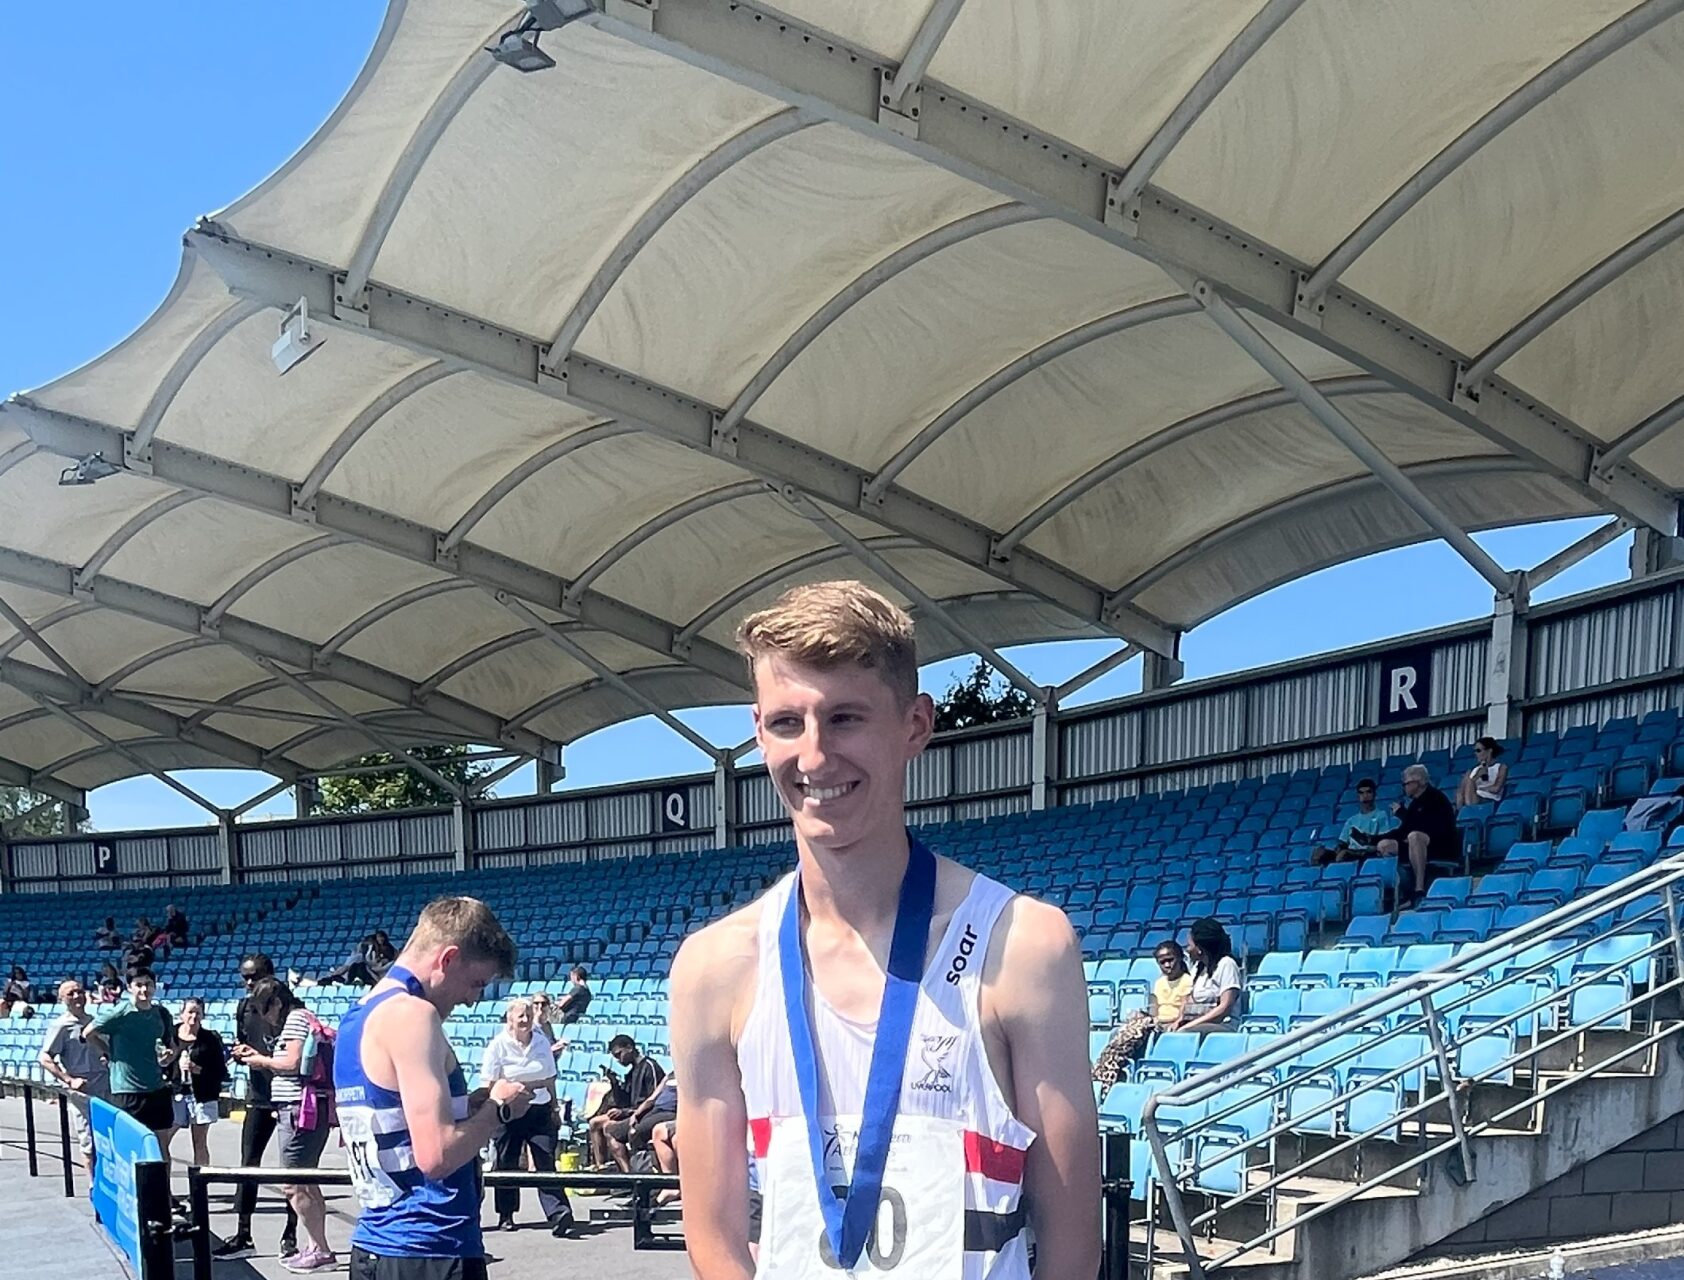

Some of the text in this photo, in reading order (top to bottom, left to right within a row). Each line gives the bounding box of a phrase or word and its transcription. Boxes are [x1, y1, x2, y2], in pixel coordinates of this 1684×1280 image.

[1389, 666, 1418, 713] R
[666, 792, 686, 827] Q
[98, 845, 111, 869] P
[946, 923, 978, 986] soar
